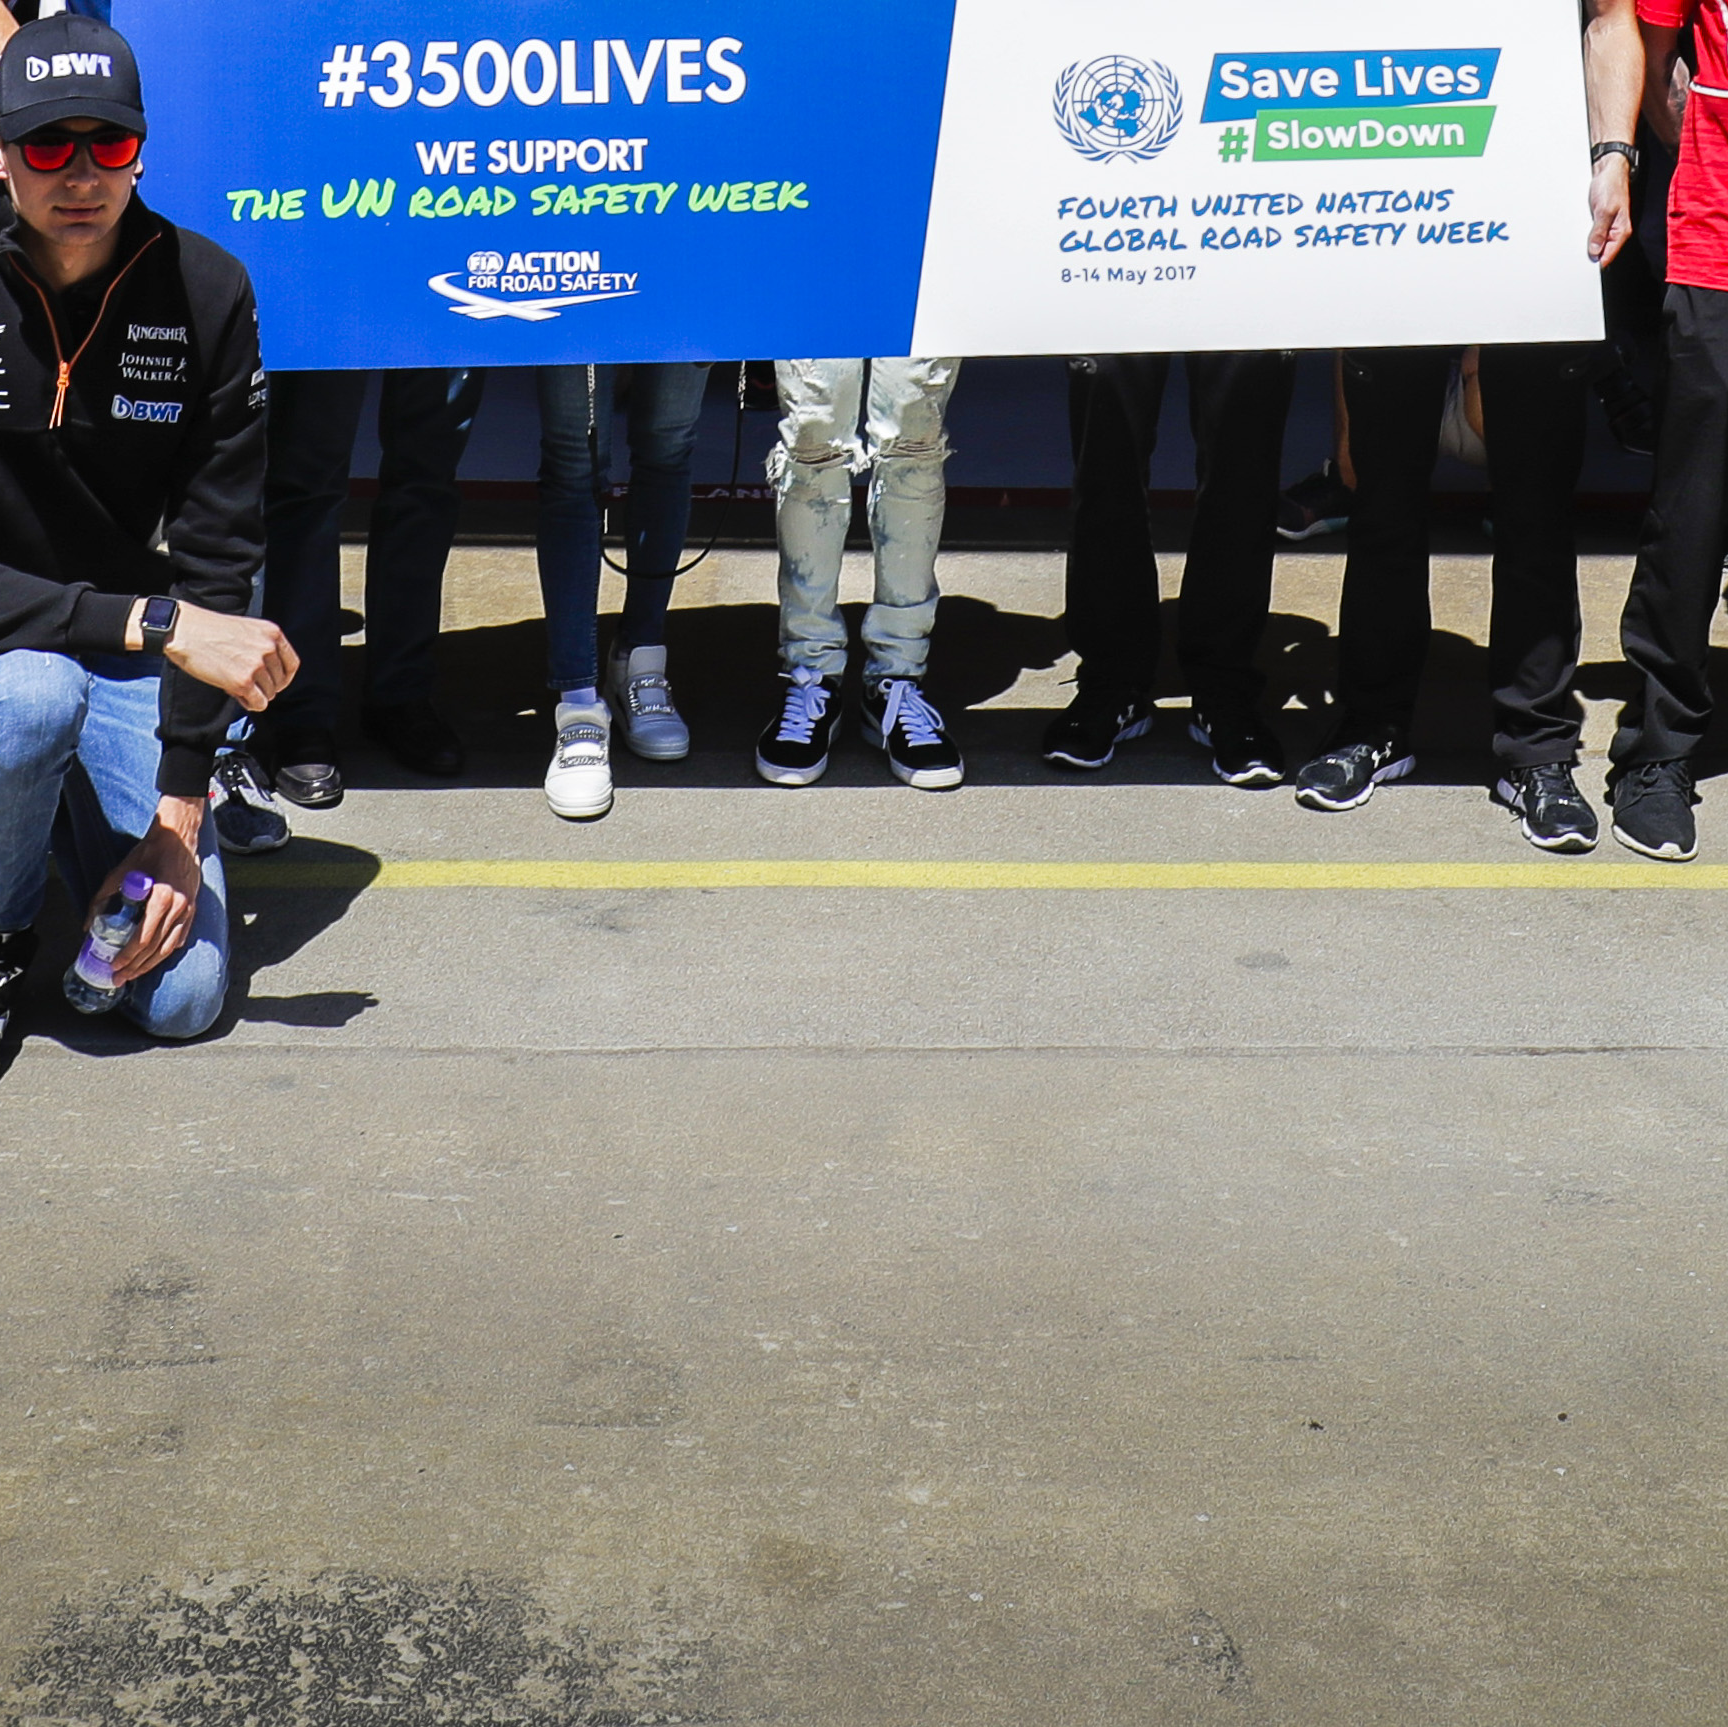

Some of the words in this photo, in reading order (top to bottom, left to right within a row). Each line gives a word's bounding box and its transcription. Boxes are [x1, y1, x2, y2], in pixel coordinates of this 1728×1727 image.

[52, 53, 111, 77] BWT
[318, 37, 747, 108] #3500LIVES
[1220, 61, 1339, 99] Save
[1354, 56, 1481, 96] Lives
[416, 141, 476, 174] WE
[487, 138, 648, 173] SUPPORT
[227, 189, 306, 221] THE
[321, 178, 396, 218] UN
[409, 185, 516, 219] ROAD
[530, 182, 679, 216] SAFETY
[688, 180, 809, 212] WEEK
[1058, 196, 1178, 219] FOURTH
[1191, 193, 1303, 217] UNITED
[1316, 189, 1455, 214] NATIONS
[1059, 229, 1187, 253] GLOBAL
[1201, 226, 1282, 250] ROAD
[1294, 223, 1407, 247] SAFETY
[1417, 221, 1510, 244] WEEK
[470, 254, 502, 272] FIA
[506, 251, 600, 273] ACTION
[468, 275, 497, 288] FOR
[501, 273, 556, 292] ROAD
[561, 272, 638, 291] SAFETY
[1061, 269, 1101, 283] 8-14
[1107, 268, 1146, 285] May
[1154, 266, 1196, 281] 2017
[127, 324, 188, 344] KINGFISHER
[118, 352, 173, 367] JOHNNIE
[122, 367, 172, 381] WALKER
[132, 401, 183, 422] BWT
